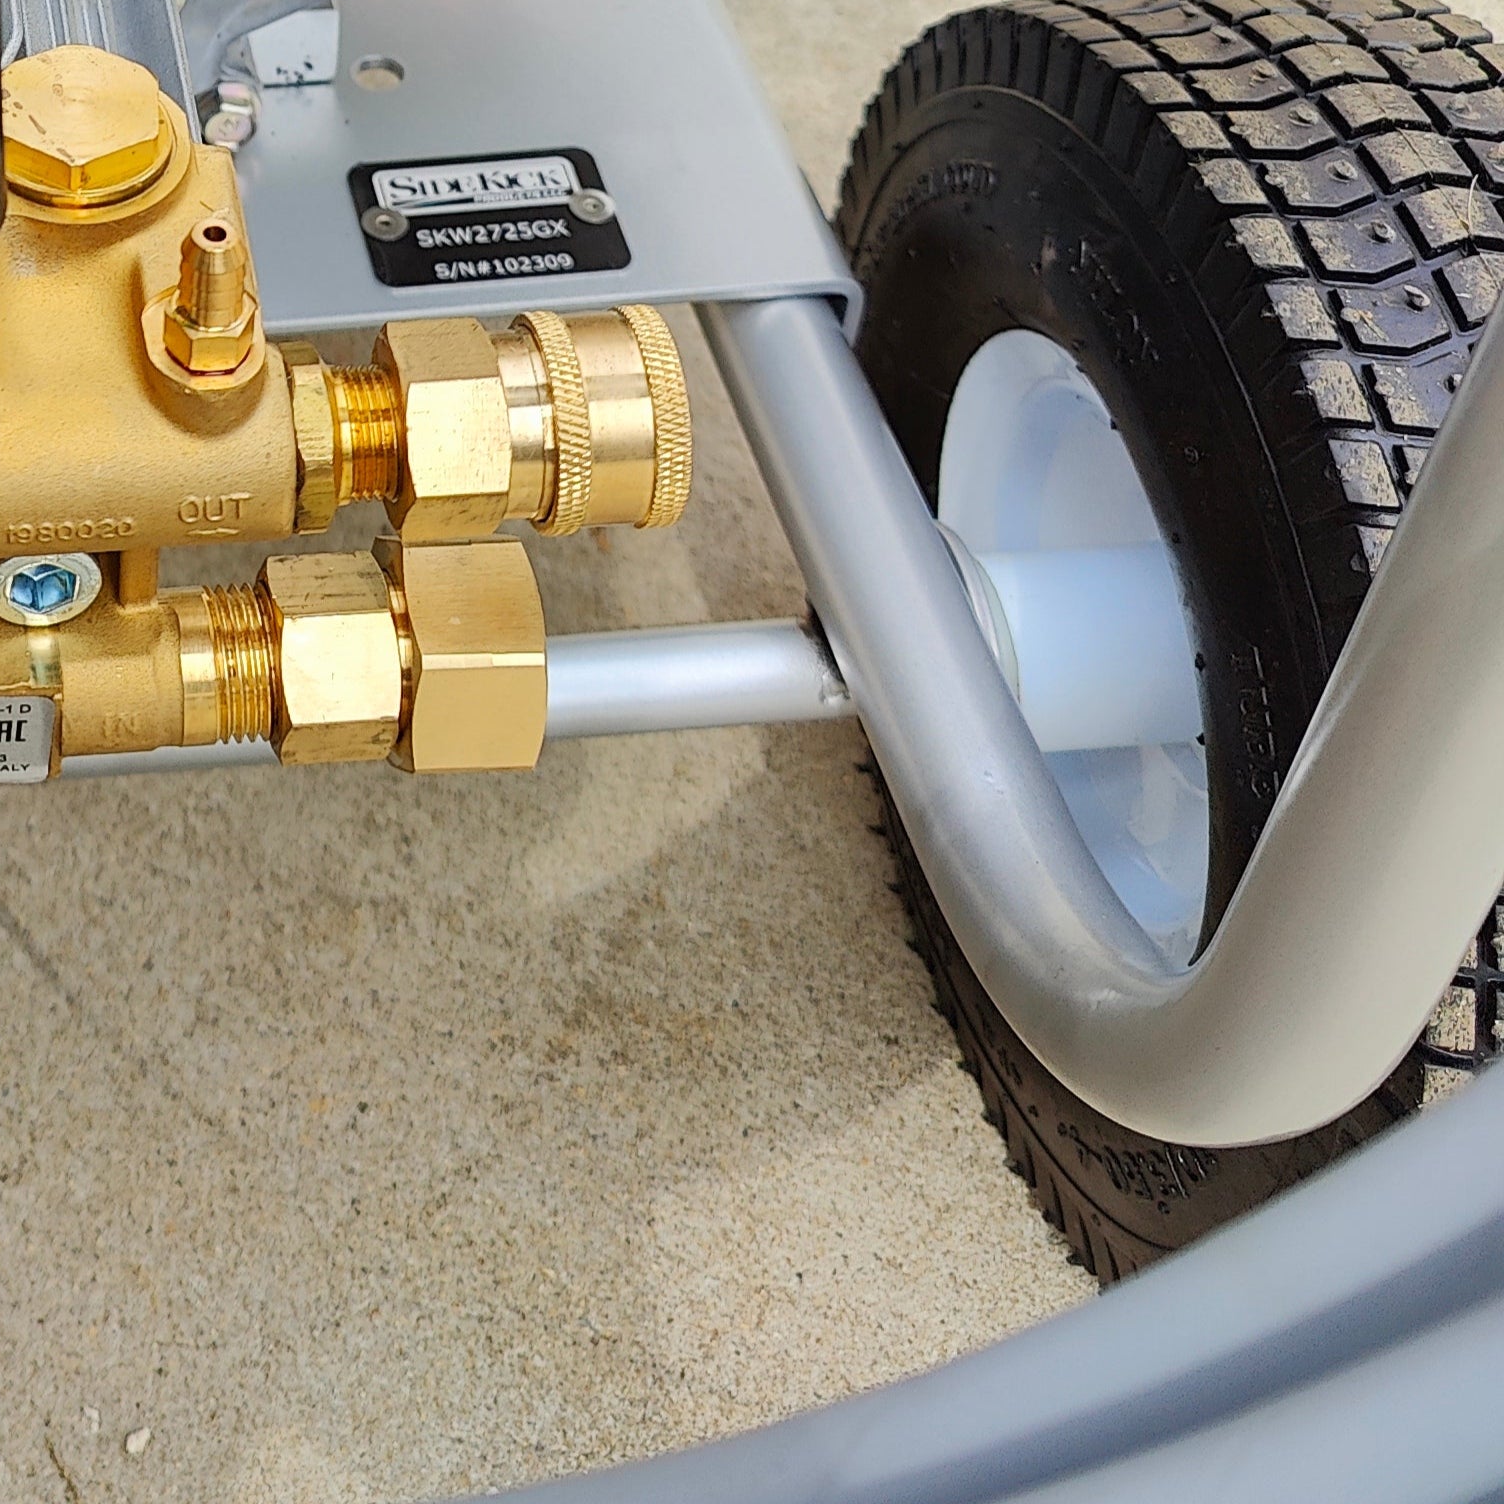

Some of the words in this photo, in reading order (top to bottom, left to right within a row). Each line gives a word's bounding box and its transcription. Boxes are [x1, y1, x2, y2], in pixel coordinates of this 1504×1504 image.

[416, 218, 572, 249] SKW2725GX
[434, 252, 575, 281] S/N#102309
[178, 491, 253, 524] OUT
[19, 704, 32, 714] D
